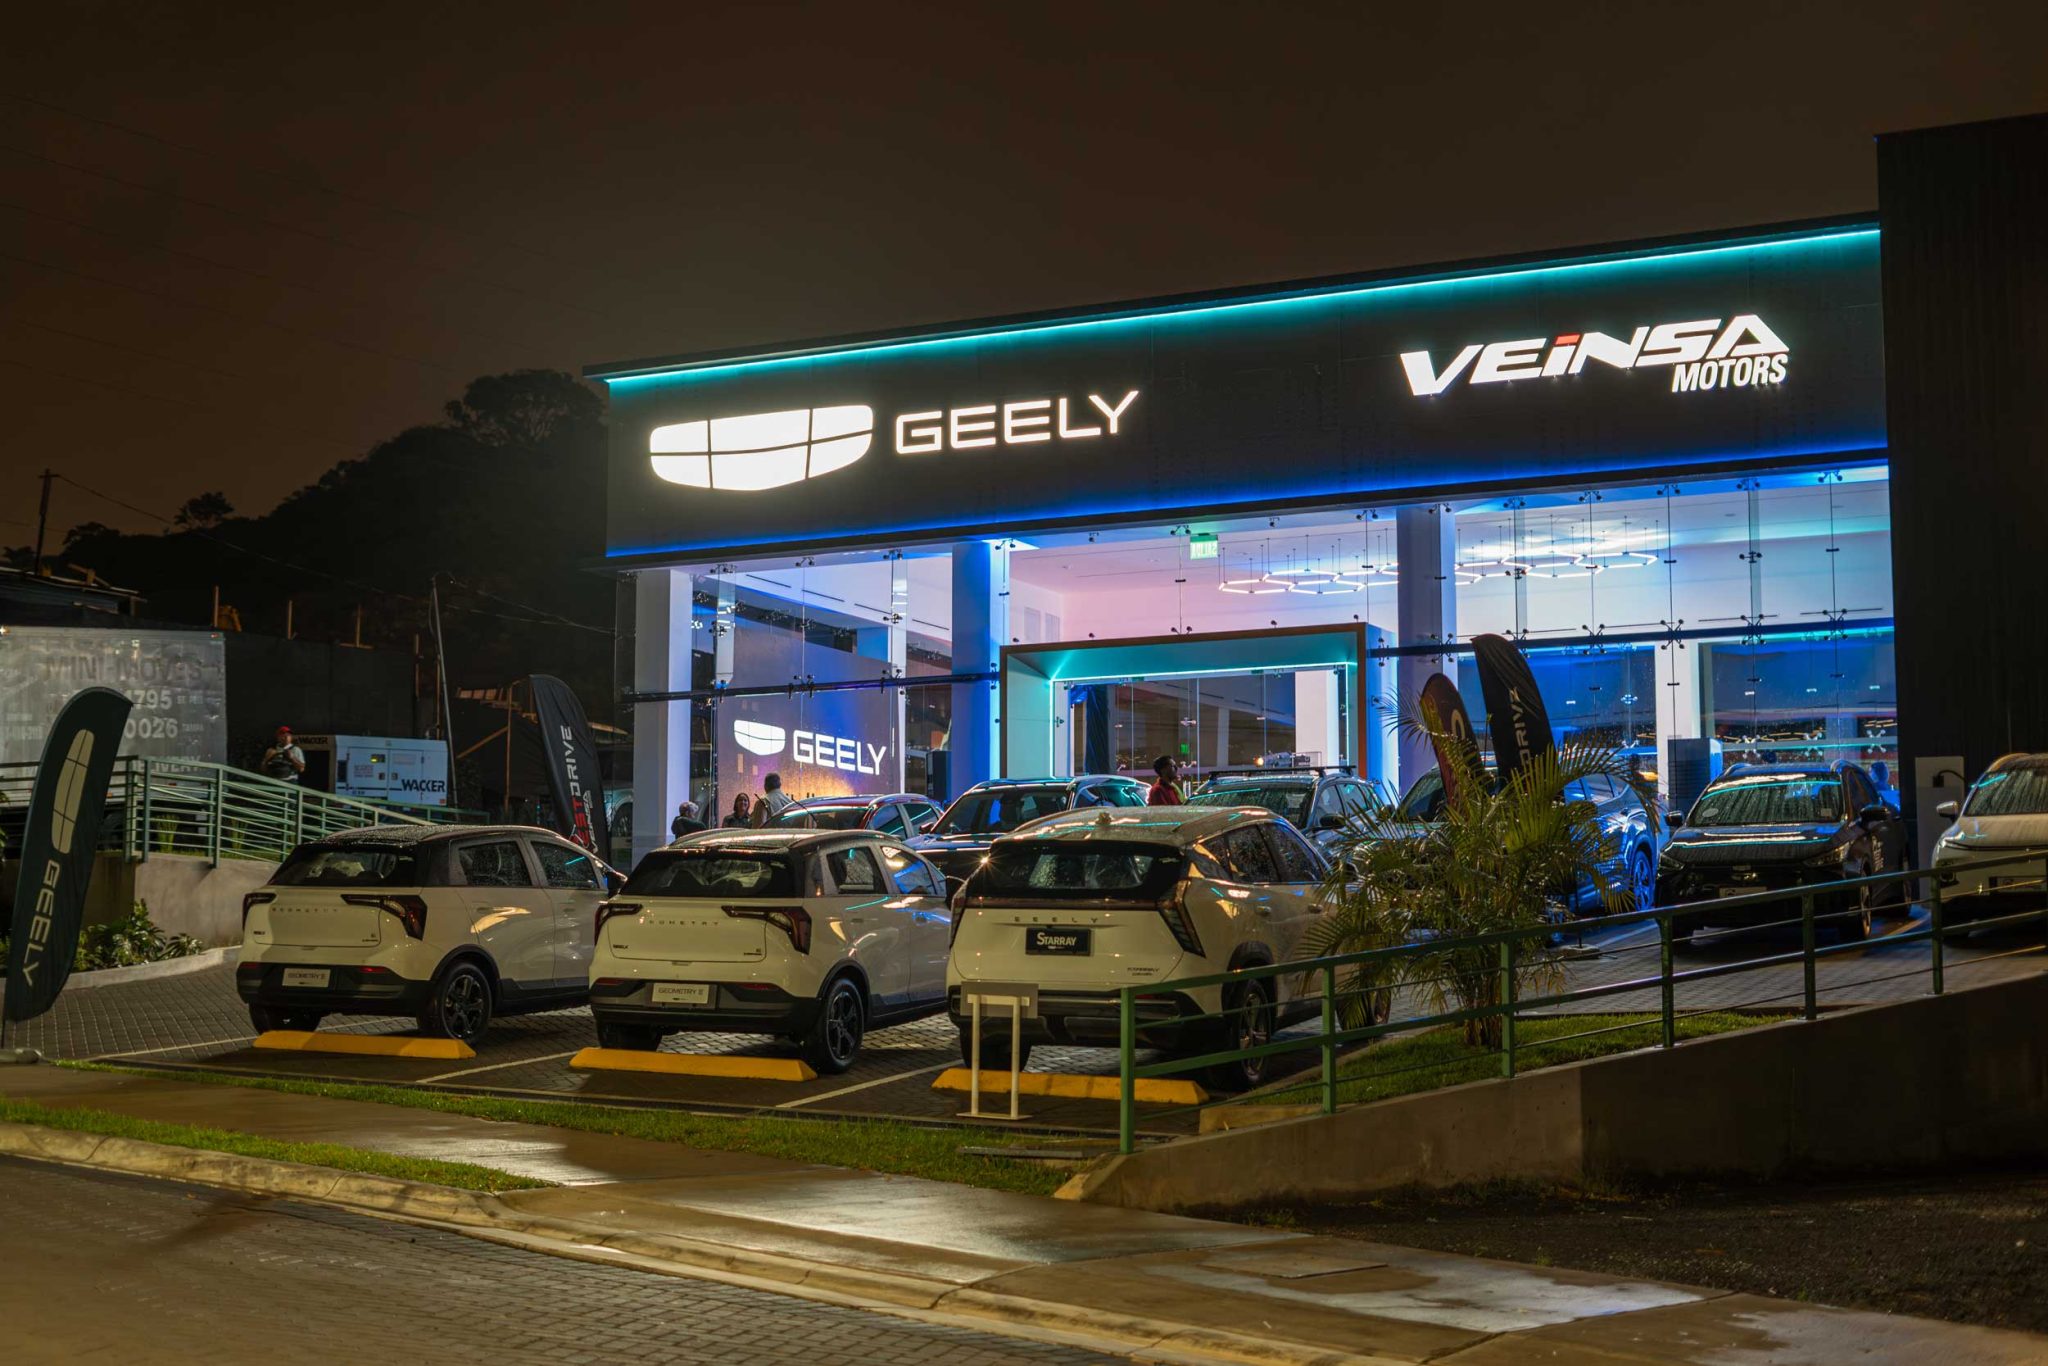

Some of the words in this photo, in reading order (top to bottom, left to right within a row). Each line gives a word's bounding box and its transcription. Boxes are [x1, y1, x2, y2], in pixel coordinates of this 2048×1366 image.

[1671, 352, 1789, 393] MOTORS
[894, 389, 1140, 456] GEELY
[124, 717, 178, 739] 0026
[793, 729, 887, 775] GEELY
[400, 778, 446, 793] WACKER
[22, 858, 61, 986] GEELY
[1014, 916, 1099, 924] GEELY
[658, 986, 696, 995] GEOMETRY
